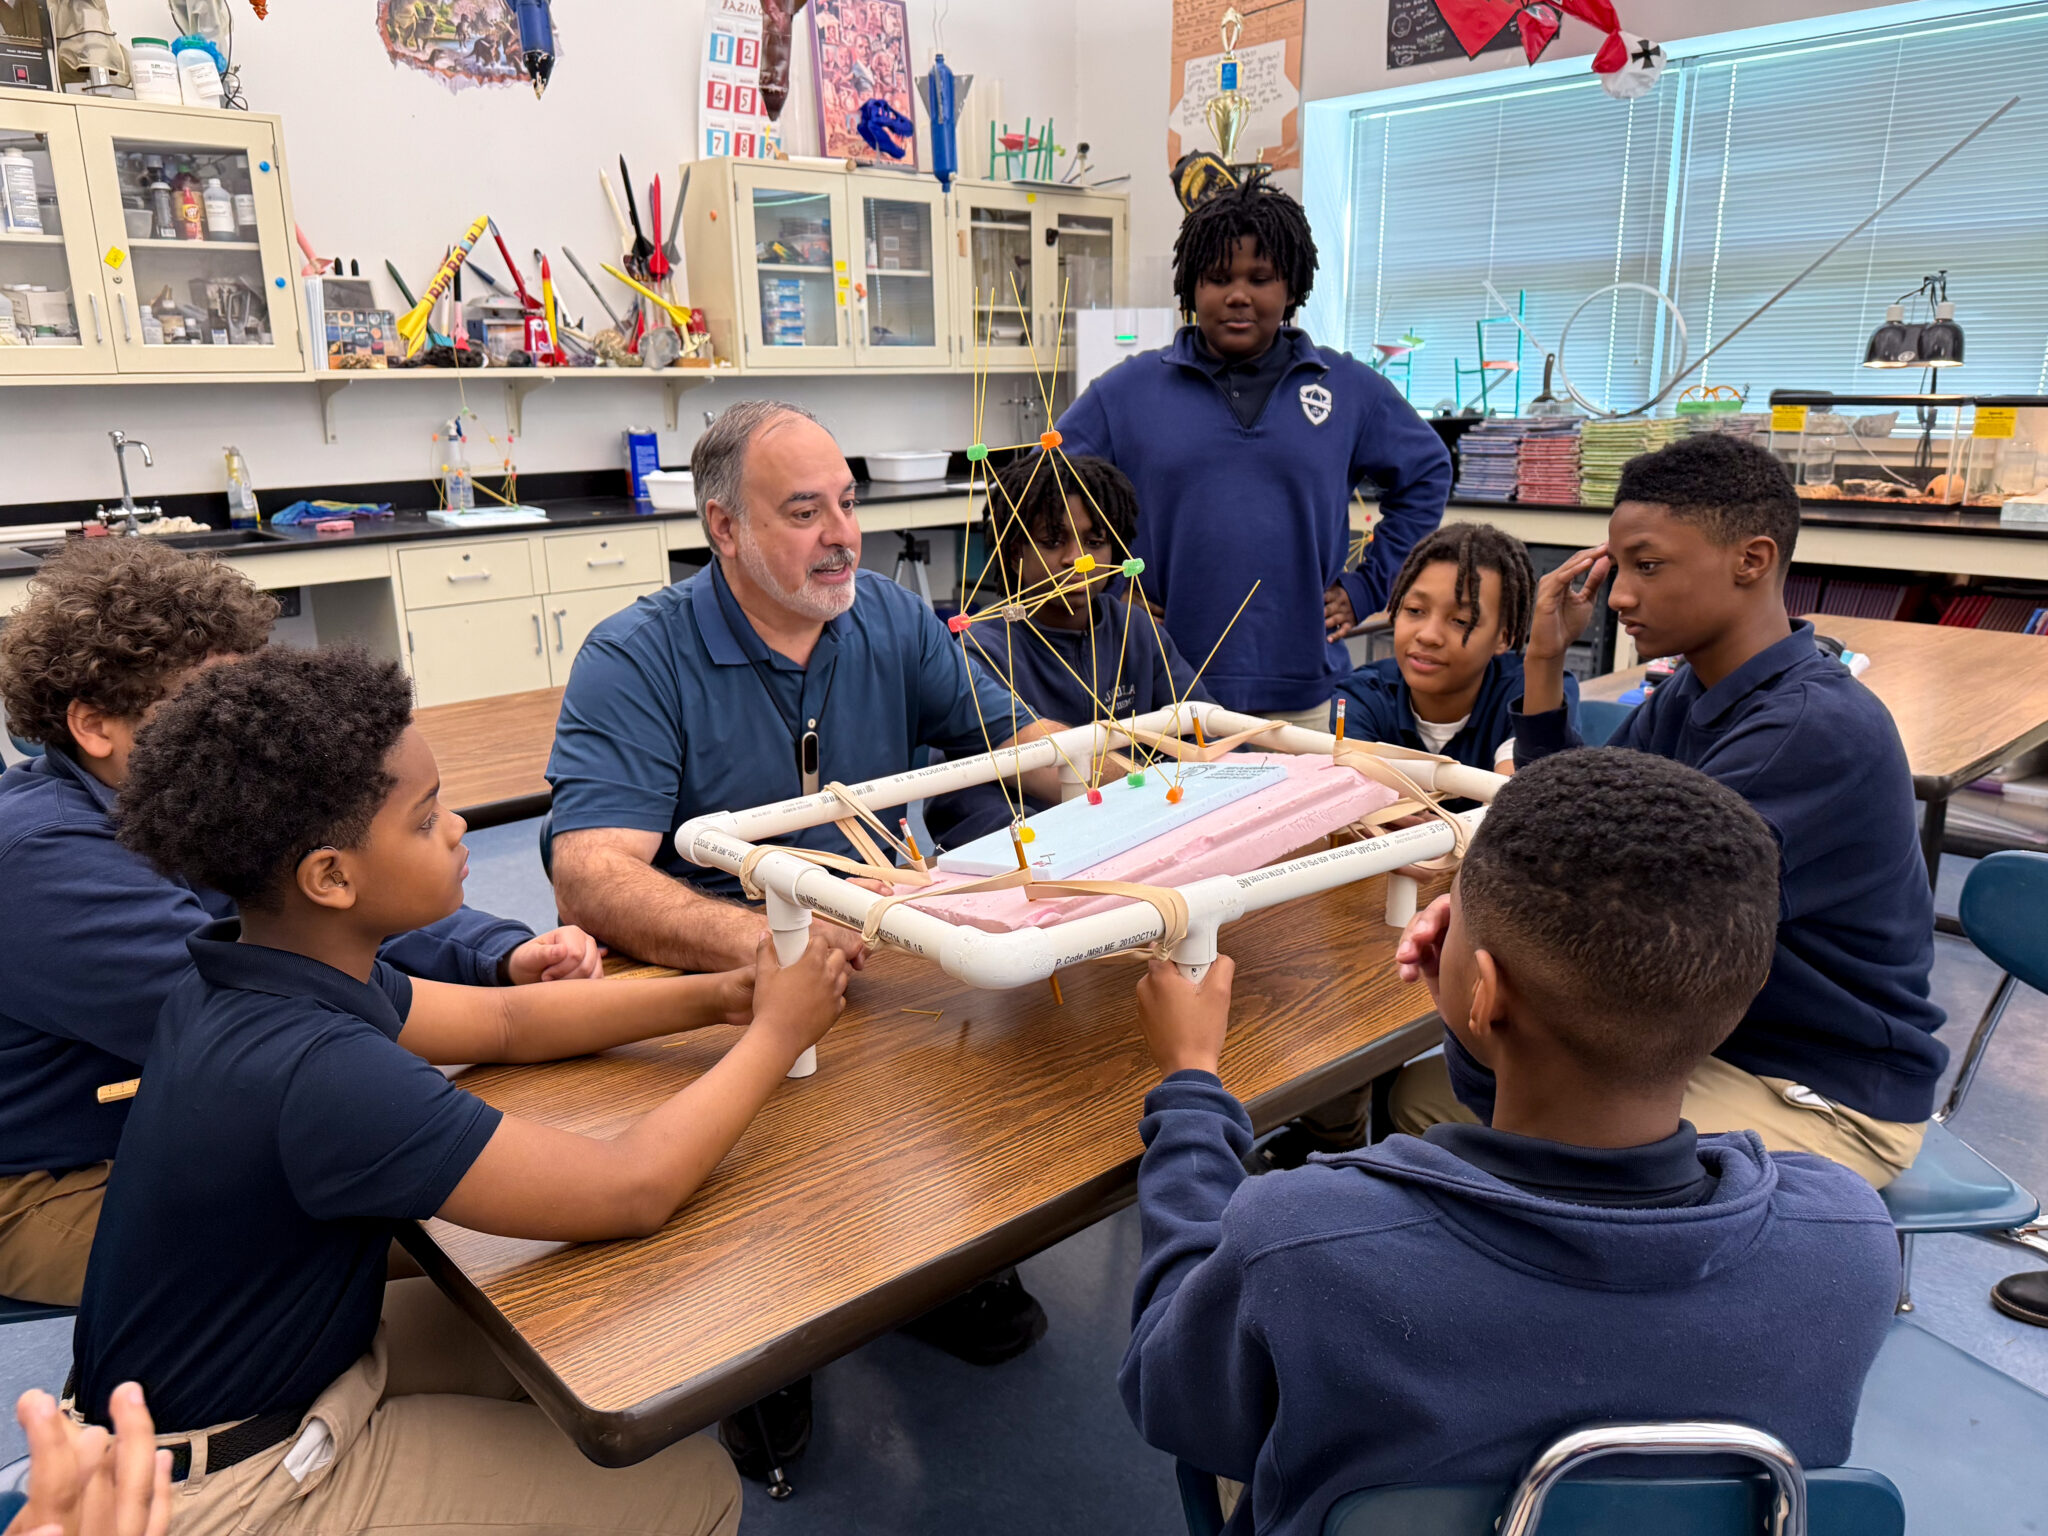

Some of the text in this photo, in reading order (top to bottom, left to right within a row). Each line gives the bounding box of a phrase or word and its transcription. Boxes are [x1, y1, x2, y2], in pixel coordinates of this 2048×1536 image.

[719, 40, 752, 60] 1 2
[714, 88, 749, 108] 4 5
[714, 137, 773, 156] 7 8 9
[1355, 841, 1381, 855] SCH40
[1267, 867, 1287, 878] ASTM
[1064, 953, 1084, 965] Code
[1084, 946, 1103, 958] JM90
[1103, 941, 1116, 951] ME
[1119, 929, 1157, 948] 2012OCT14
